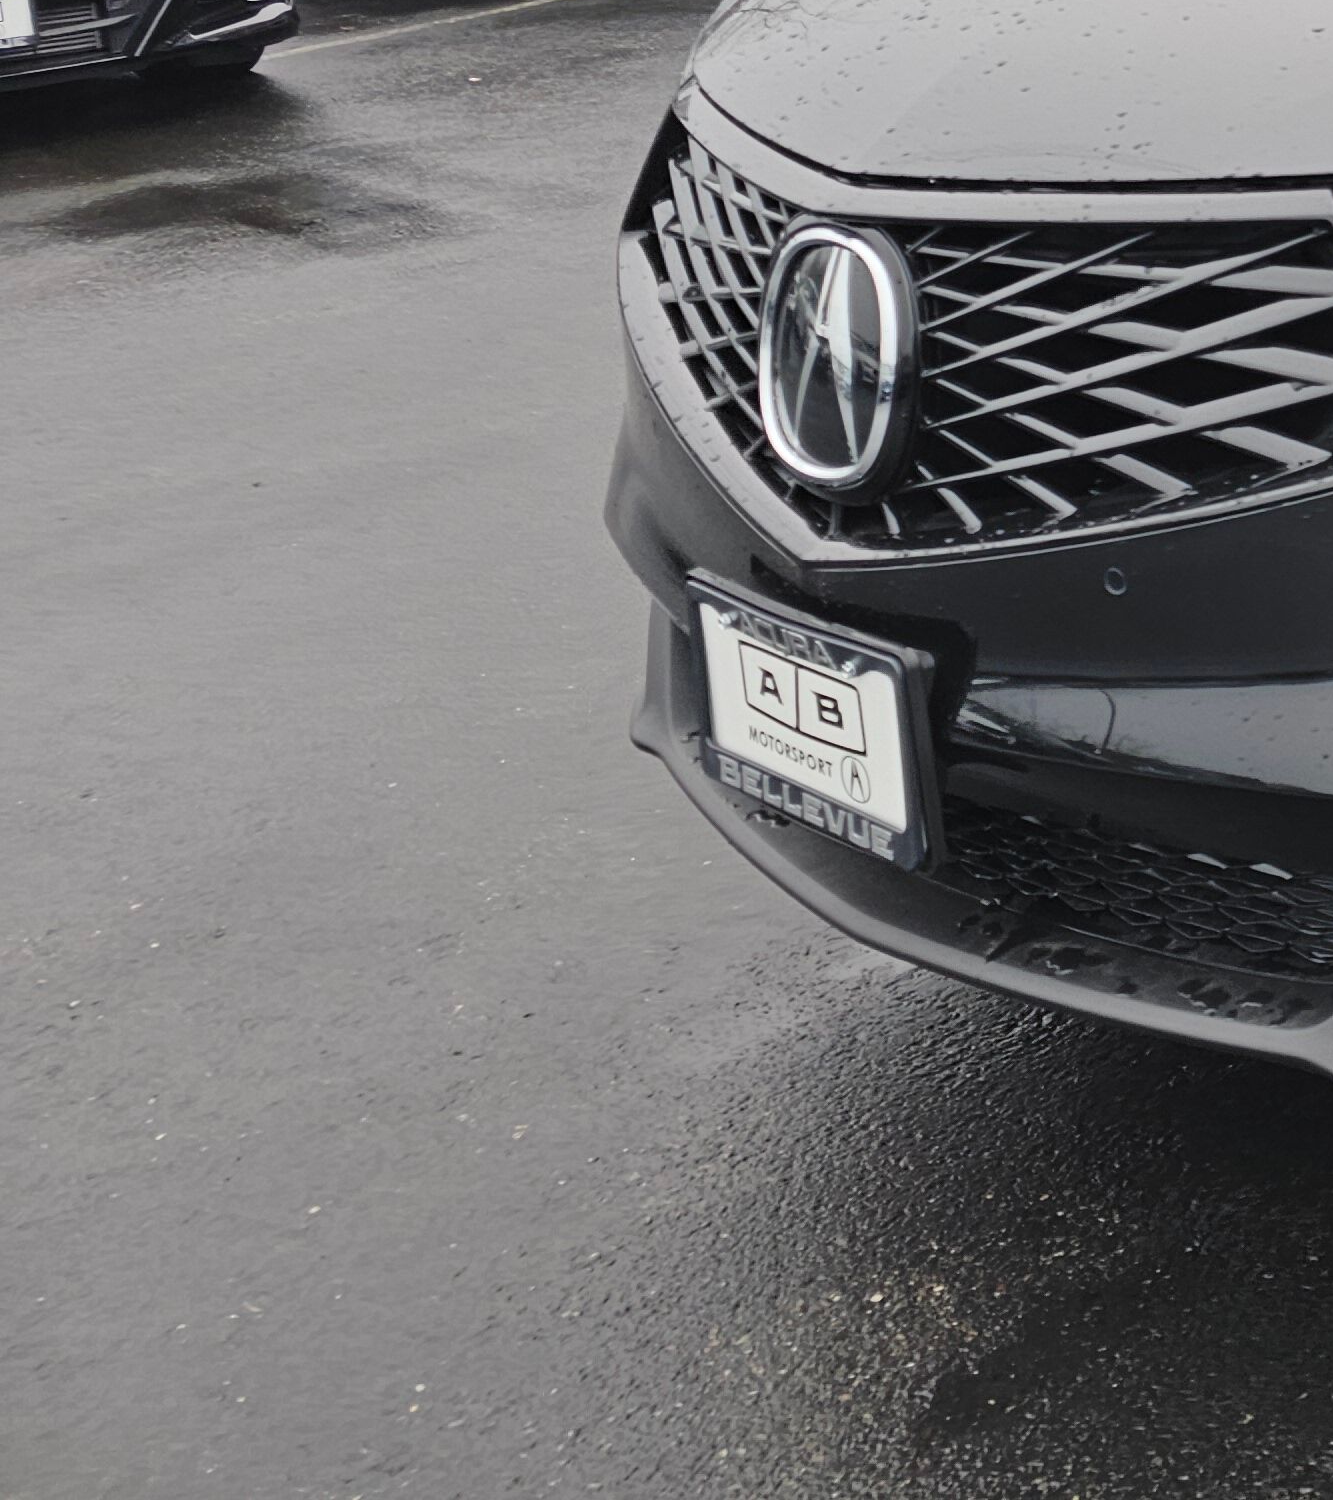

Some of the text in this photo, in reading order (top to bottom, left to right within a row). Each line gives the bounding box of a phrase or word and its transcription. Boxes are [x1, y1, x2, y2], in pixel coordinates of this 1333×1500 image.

[739, 612, 837, 668] ACURA
[759, 667, 843, 729] A B
[749, 726, 834, 778] MOTORSPORT
[719, 756, 895, 861] BELLEVUE
